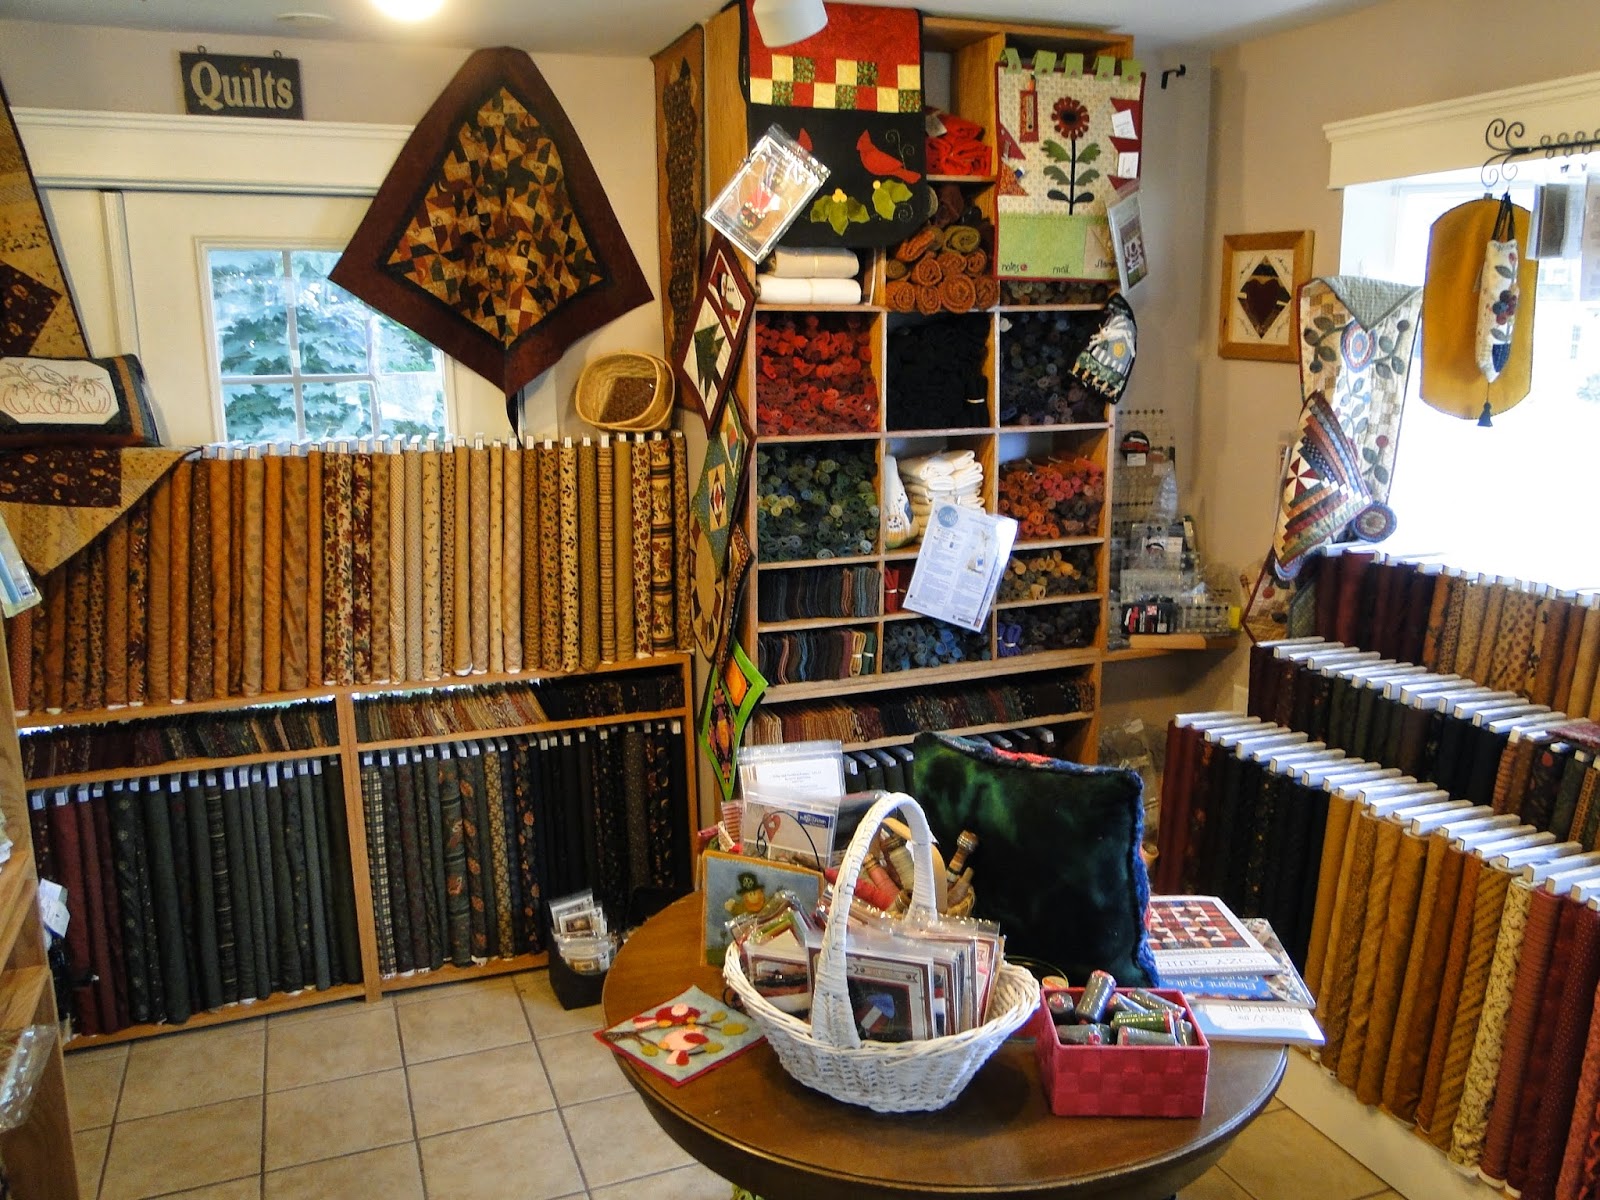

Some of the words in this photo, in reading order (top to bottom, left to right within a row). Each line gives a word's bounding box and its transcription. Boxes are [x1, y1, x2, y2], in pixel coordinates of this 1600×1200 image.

[190, 61, 294, 111] Quilts
[1217, 958, 1267, 966] COZY
[1209, 981, 1256, 991] Elegant
